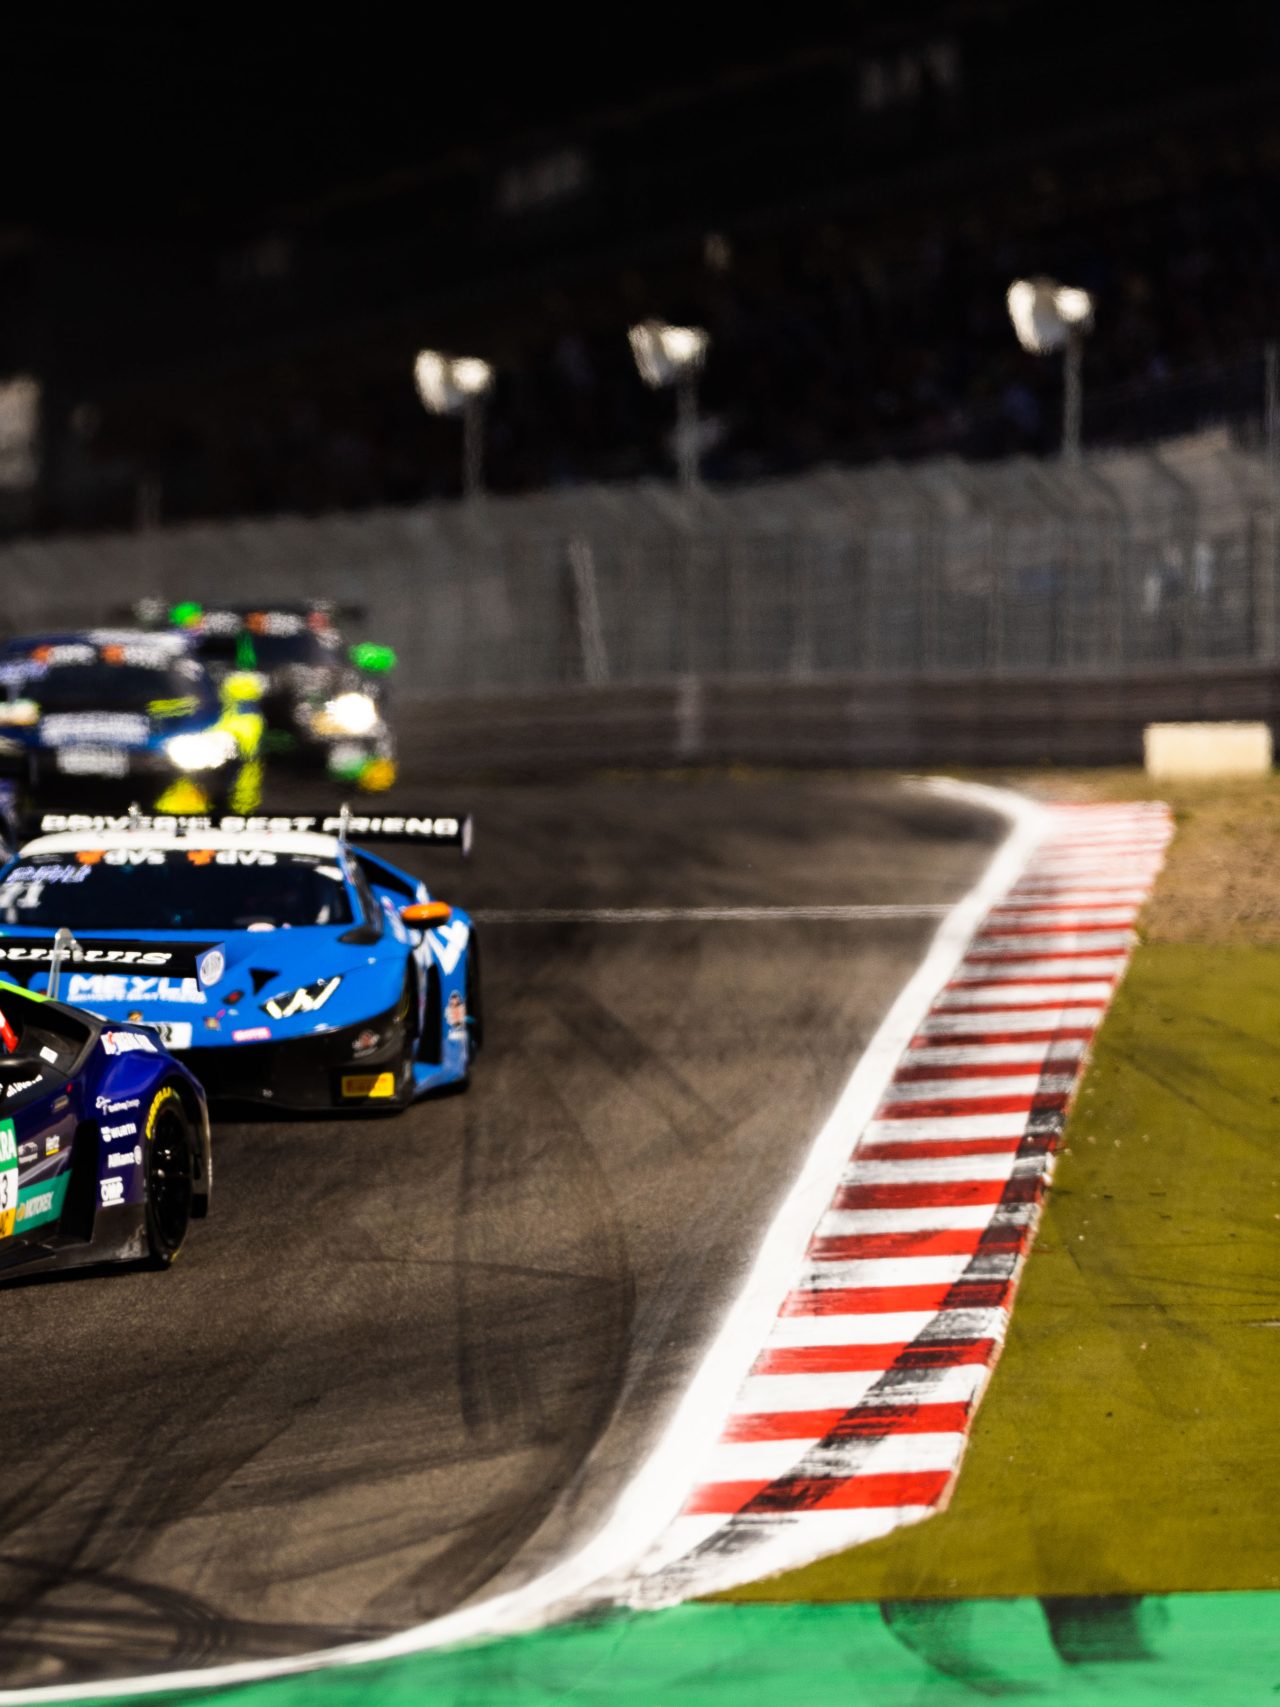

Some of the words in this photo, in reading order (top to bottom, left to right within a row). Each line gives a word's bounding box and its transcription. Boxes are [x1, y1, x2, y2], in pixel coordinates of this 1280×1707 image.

[221, 814, 317, 833] BEST
[323, 816, 460, 836] FRIEND
[104, 848, 166, 866] dvs
[215, 848, 278, 866] dvs
